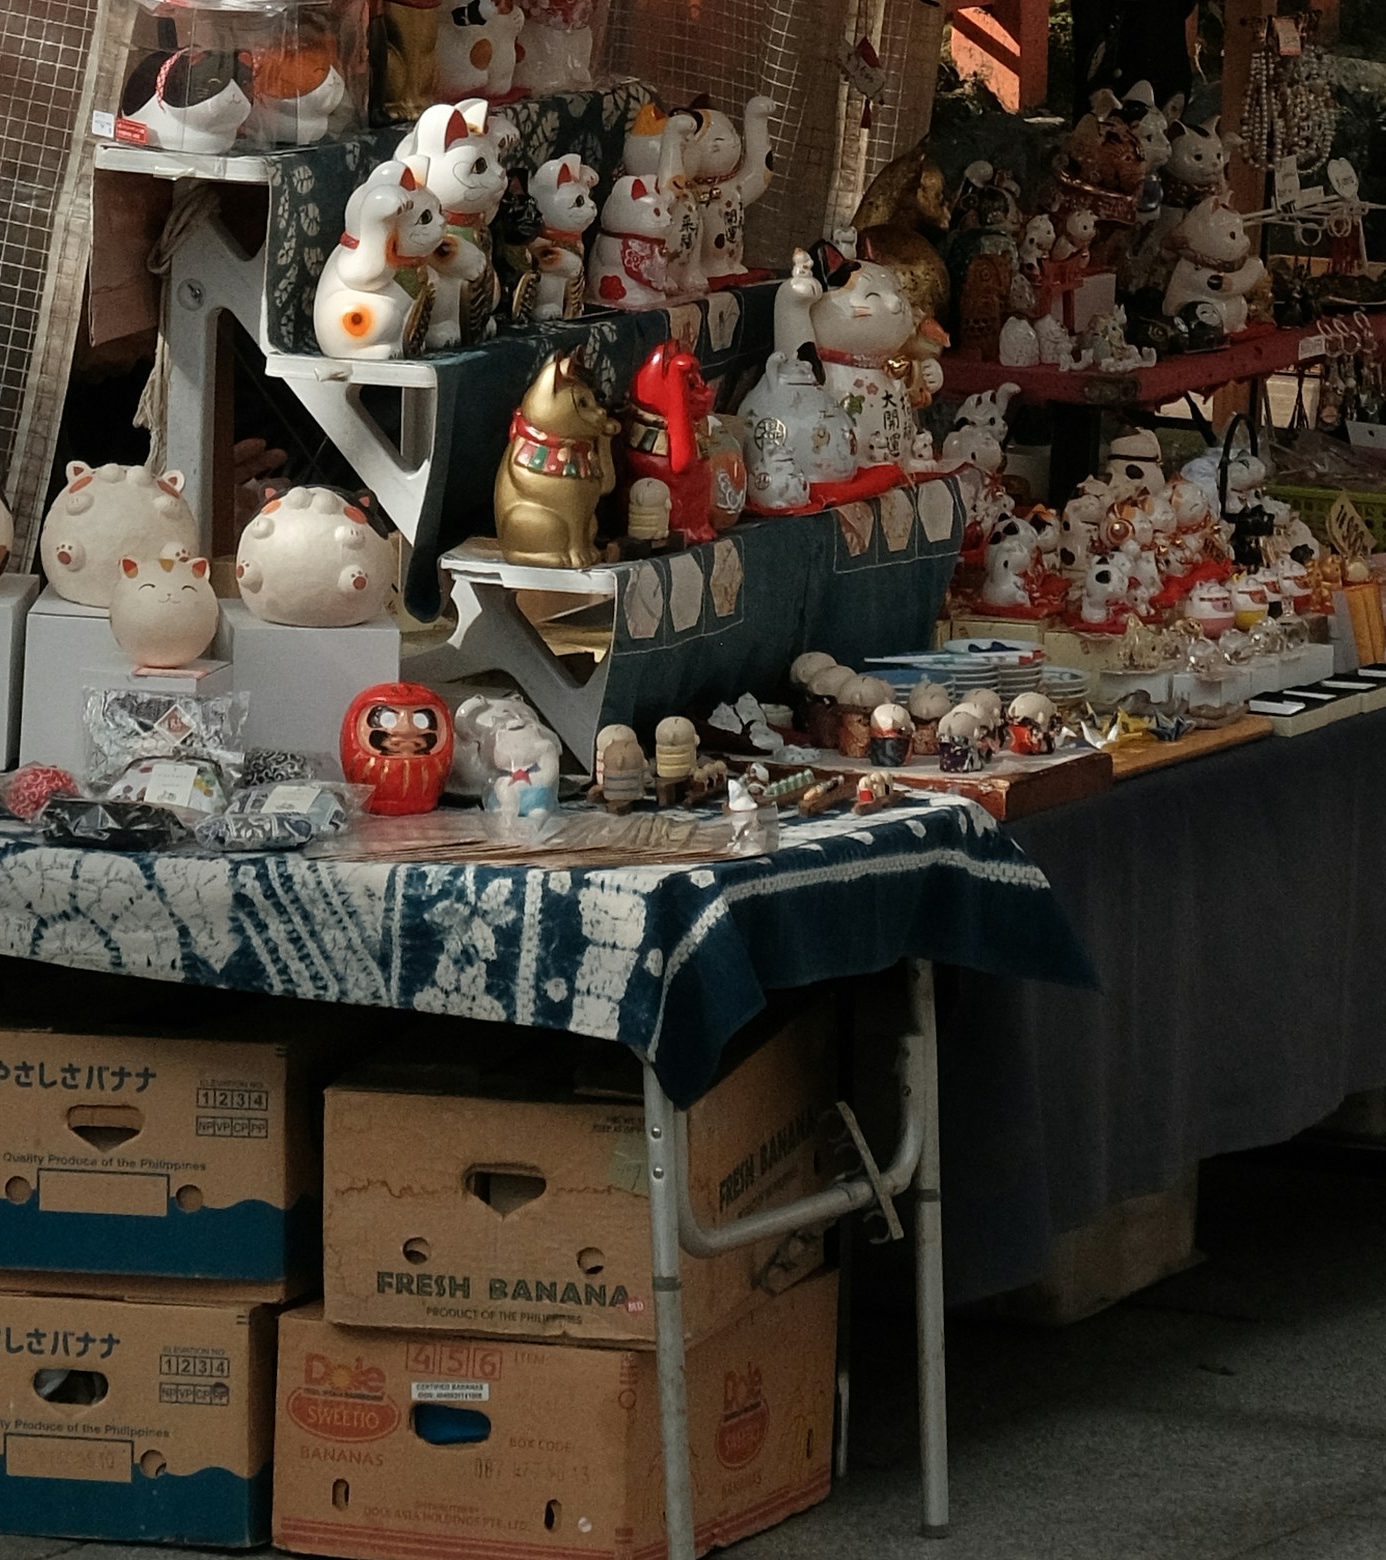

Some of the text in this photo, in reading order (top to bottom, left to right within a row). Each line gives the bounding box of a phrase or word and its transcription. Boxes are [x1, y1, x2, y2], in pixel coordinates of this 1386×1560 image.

[881, 389, 902, 458] 大開運
[219, 1092, 228, 1107] 2
[254, 1094, 263, 1108] 4
[3, 1151, 206, 1172] Quality Produce of the Philippines
[376, 1270, 631, 1308] FRESH BANANA
[426, 1307, 478, 1320] PRODUCT
[480, 1309, 497, 1320] OF
[498, 1310, 517, 1322] THE
[181, 1359, 190, 1373] 2
[215, 1360, 224, 1375] 4
[411, 1345, 497, 1376] 4 5 6
[307, 1405, 380, 1430] SWEETIO
[13, 1419, 63, 1432] Produce
[67, 1422, 80, 1432] of
[82, 1423, 101, 1434] the
[104, 1424, 171, 1439] Philippines
[300, 1445, 384, 1467] BANANAS
